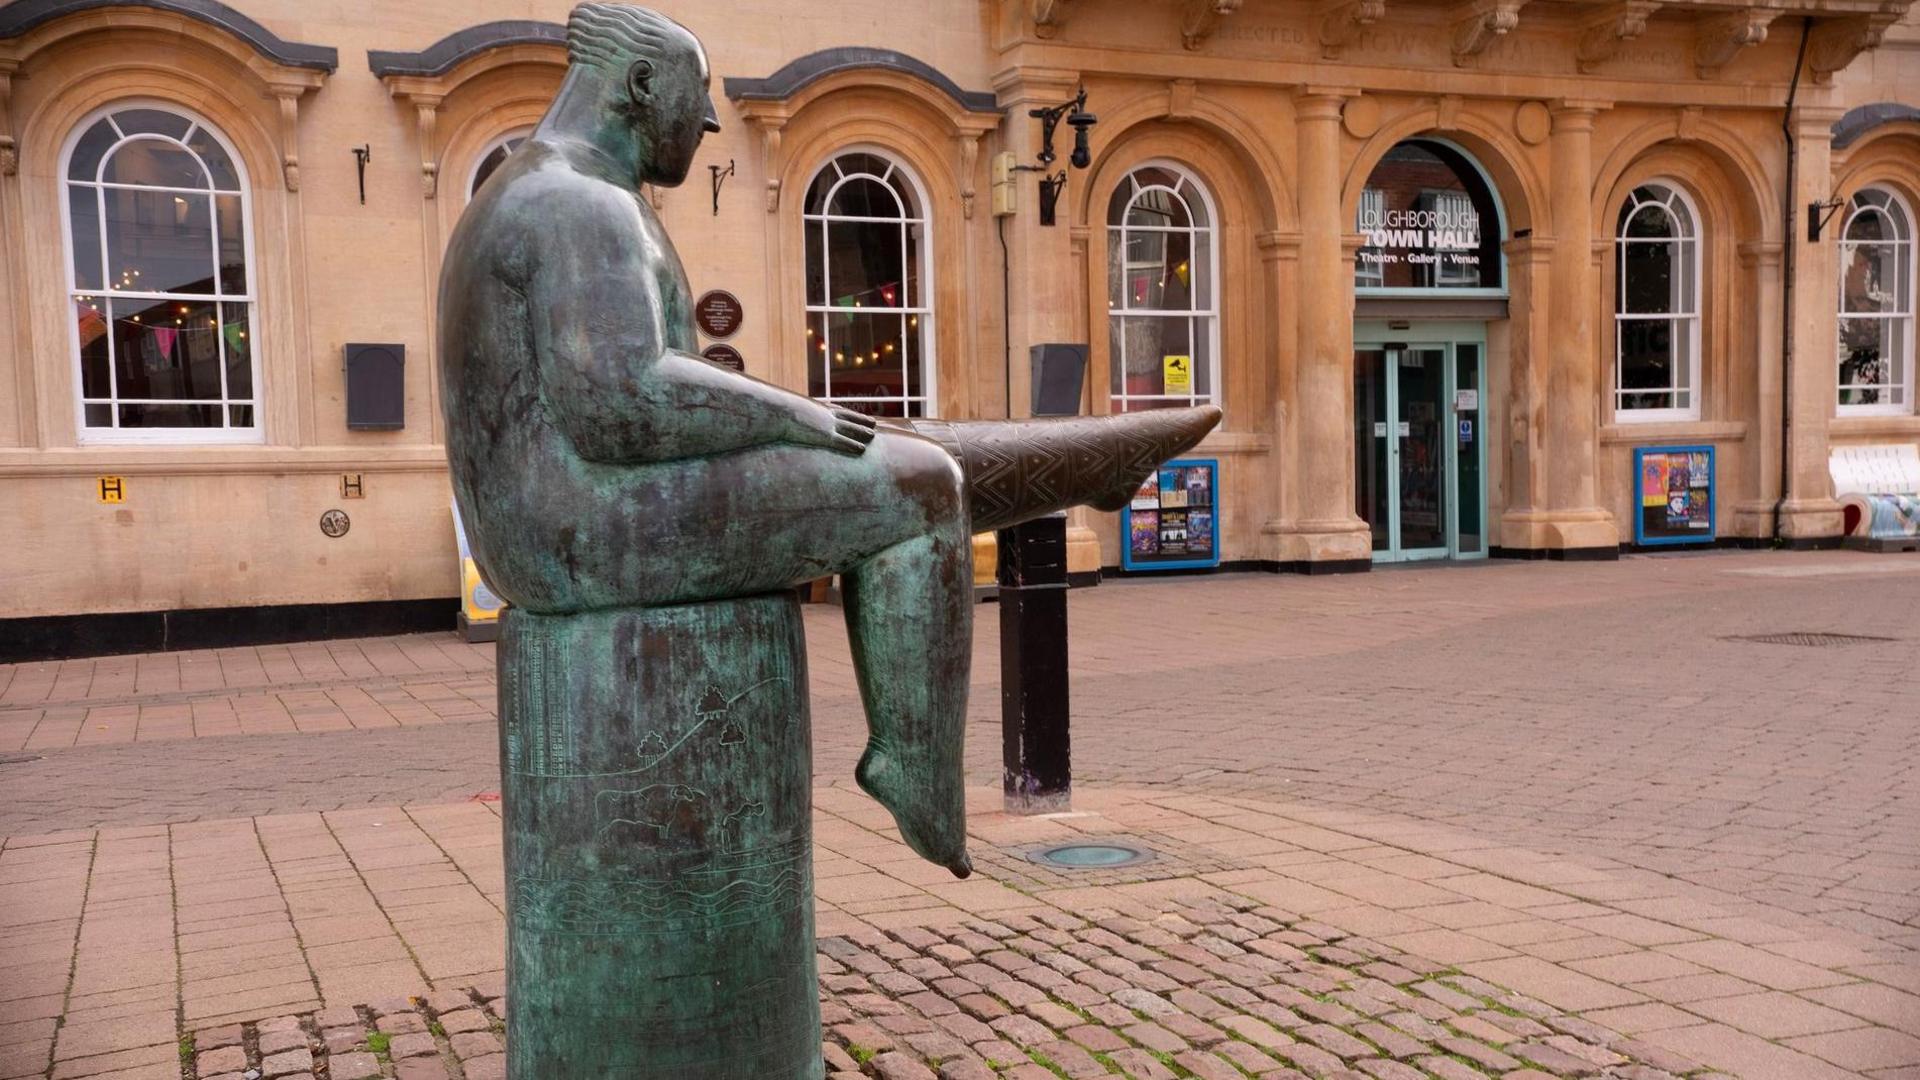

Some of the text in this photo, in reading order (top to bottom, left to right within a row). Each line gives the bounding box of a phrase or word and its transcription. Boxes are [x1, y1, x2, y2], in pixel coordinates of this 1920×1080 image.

[1360, 210, 1480, 228] LOUGHBOROUGH
[1360, 230, 1480, 249] TOWN HALL
[1360, 252, 1480, 265] Theatre Gallery Venue
[101, 478, 122, 500] H
[344, 475, 363, 497] H
